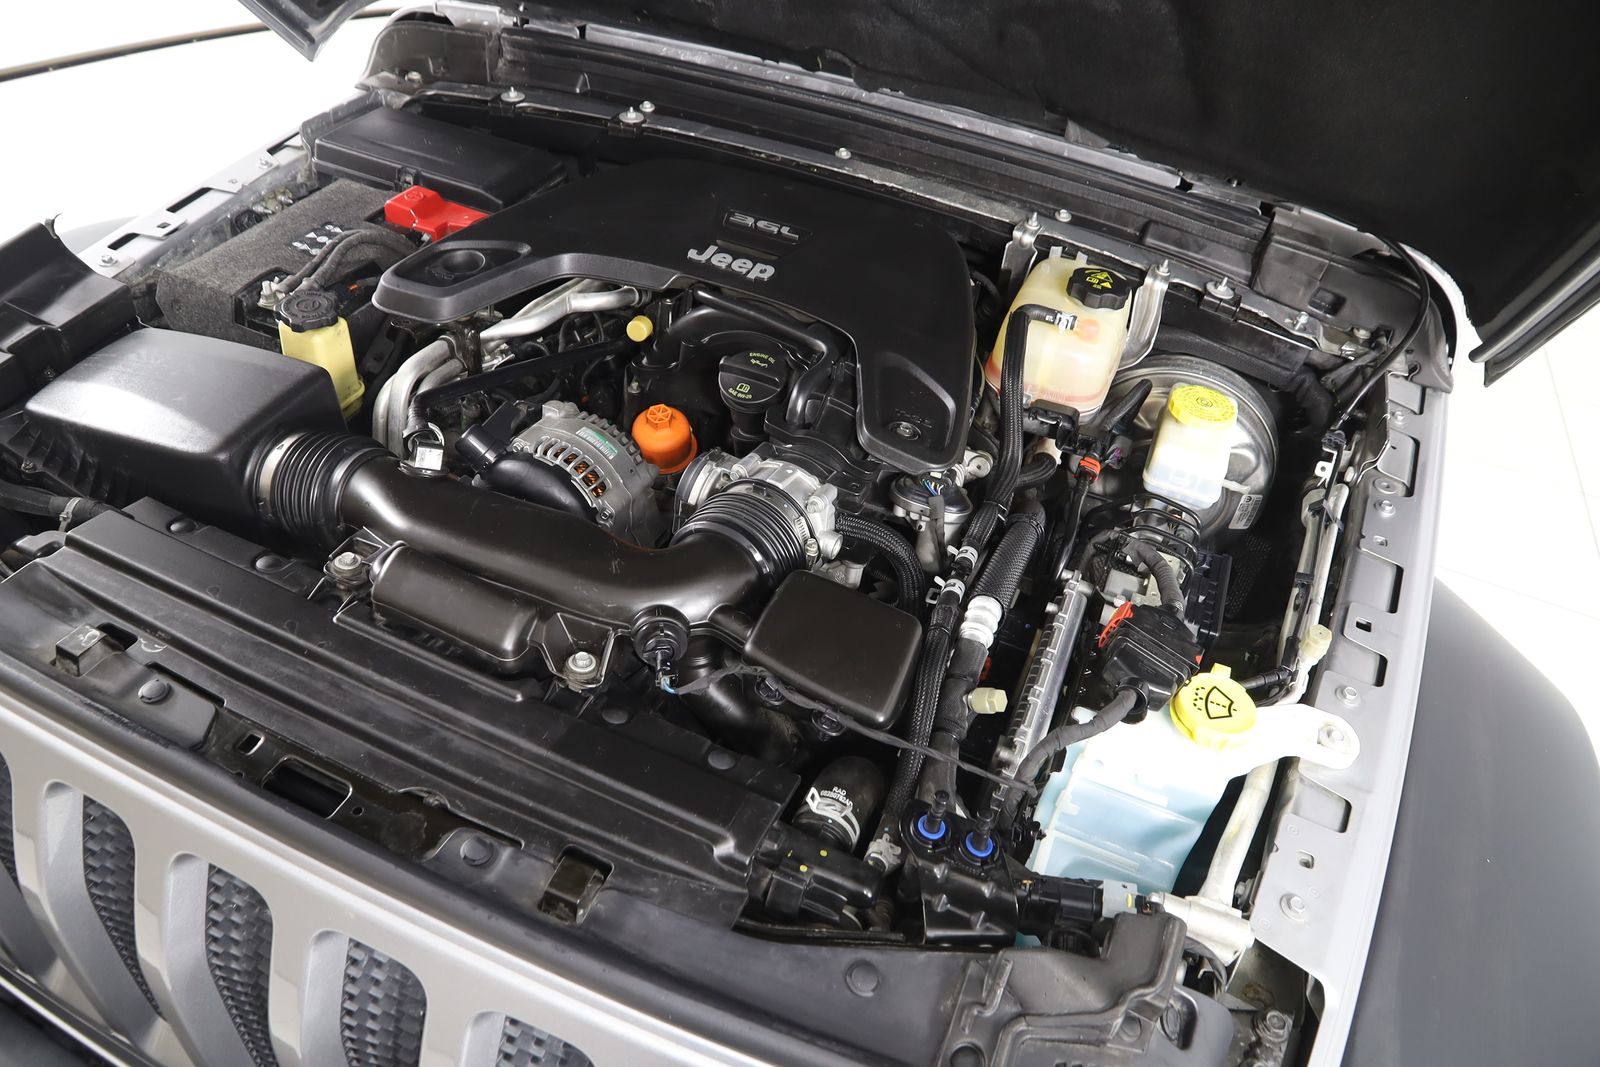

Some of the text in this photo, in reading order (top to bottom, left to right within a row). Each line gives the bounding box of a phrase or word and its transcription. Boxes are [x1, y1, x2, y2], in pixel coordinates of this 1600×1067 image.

[687, 244, 776, 282] Jeep
[749, 352, 776, 364] ENGINE OIL
[727, 387, 738, 397] SAE
[832, 786, 847, 796] RAD
